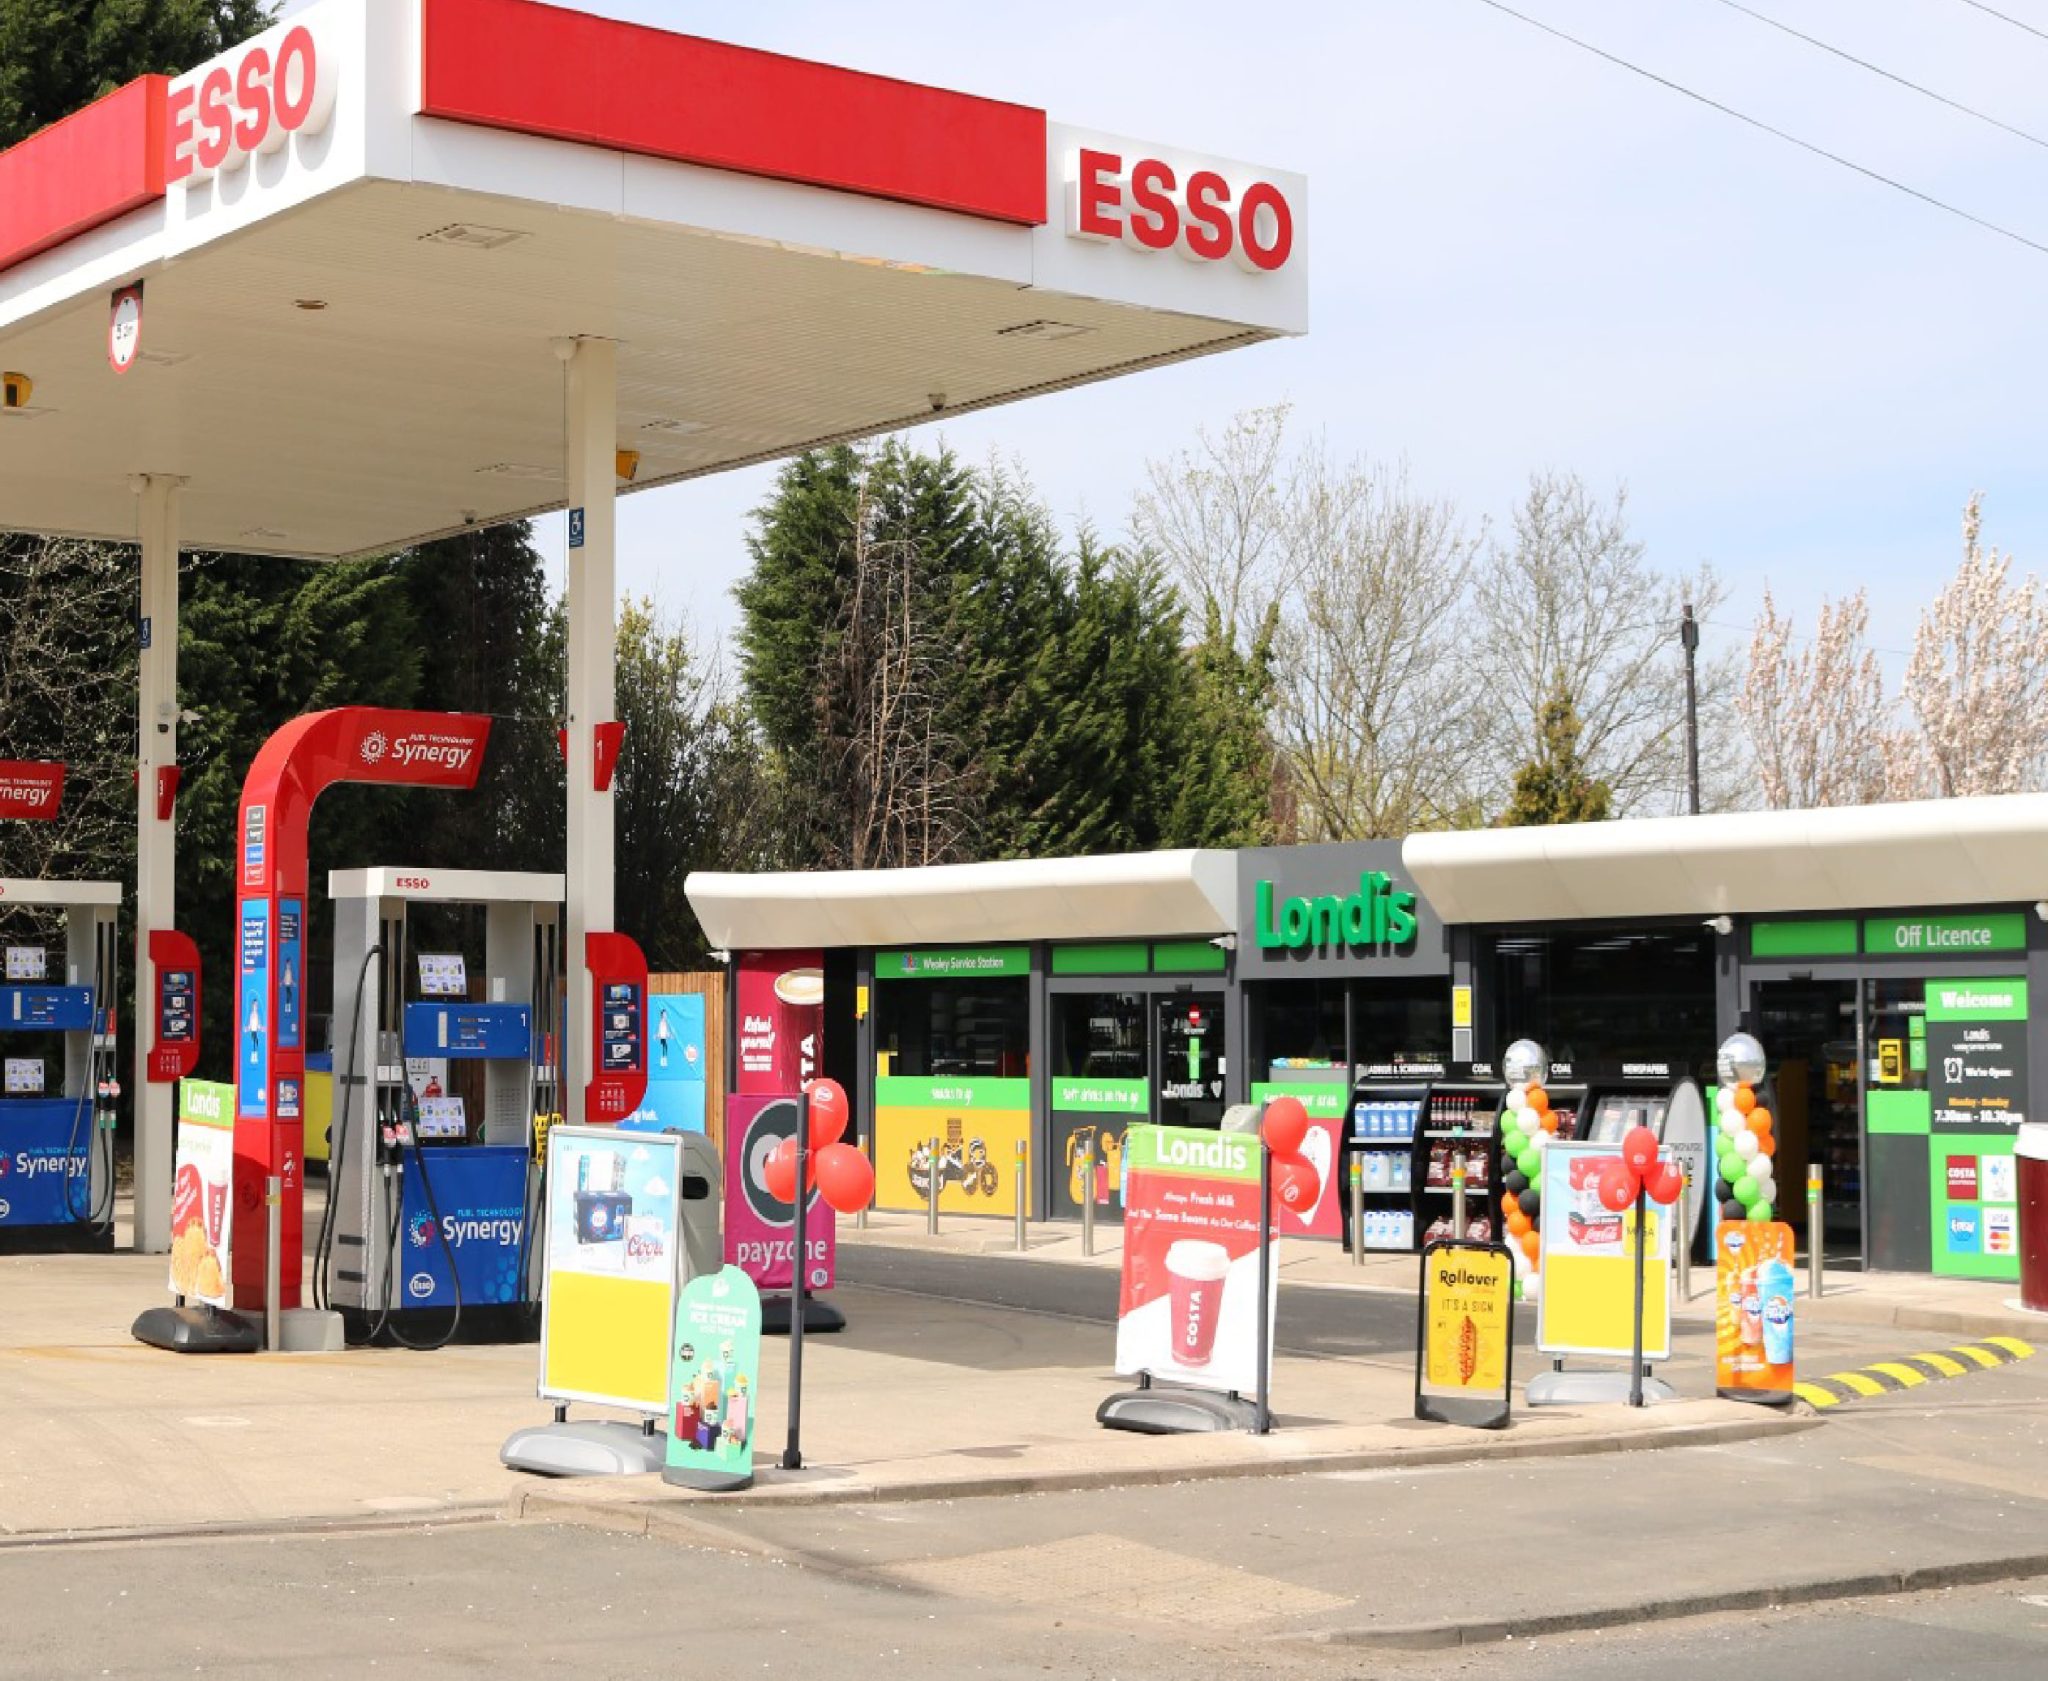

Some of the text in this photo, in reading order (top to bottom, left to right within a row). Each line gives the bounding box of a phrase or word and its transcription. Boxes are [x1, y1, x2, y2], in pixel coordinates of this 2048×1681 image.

[166, 25, 316, 184] ESSO
[1080, 148, 1292, 271] ESSO
[392, 738, 472, 769] Synergy
[596, 739, 603, 761] 1
[396, 878, 430, 889] ESSO
[1256, 871, 1418, 948] Londis
[1895, 924, 1992, 948] Off Licence
[950, 957, 977, 969] Service
[978, 956, 1004, 968] Station
[83, 992, 90, 1005] 3
[1940, 991, 2013, 1009] Welcome
[520, 1012, 526, 1028] 1
[1472, 1063, 1492, 1074] COAL
[1551, 1063, 1571, 1074] COAL
[1622, 1064, 1669, 1075] NEWSPAPERS
[1164, 1080, 1204, 1099] Londis
[187, 1083, 221, 1120] Londis
[1156, 1130, 1247, 1170] Londis
[16, 1152, 87, 1178] Synergy
[1948, 1167, 1977, 1179] COSTA
[1190, 1191, 1214, 1205] Fresh
[1215, 1194, 1235, 1207] Milk
[1155, 1208, 1180, 1222] Same
[1181, 1211, 1209, 1225] Beans
[442, 1215, 524, 1248] Synergy
[626, 1233, 664, 1258] Coors
[1439, 1269, 1499, 1289] Rollover
[1441, 1299, 1494, 1314] IT'S A SIGN
[1185, 1290, 1203, 1348] COSTA
